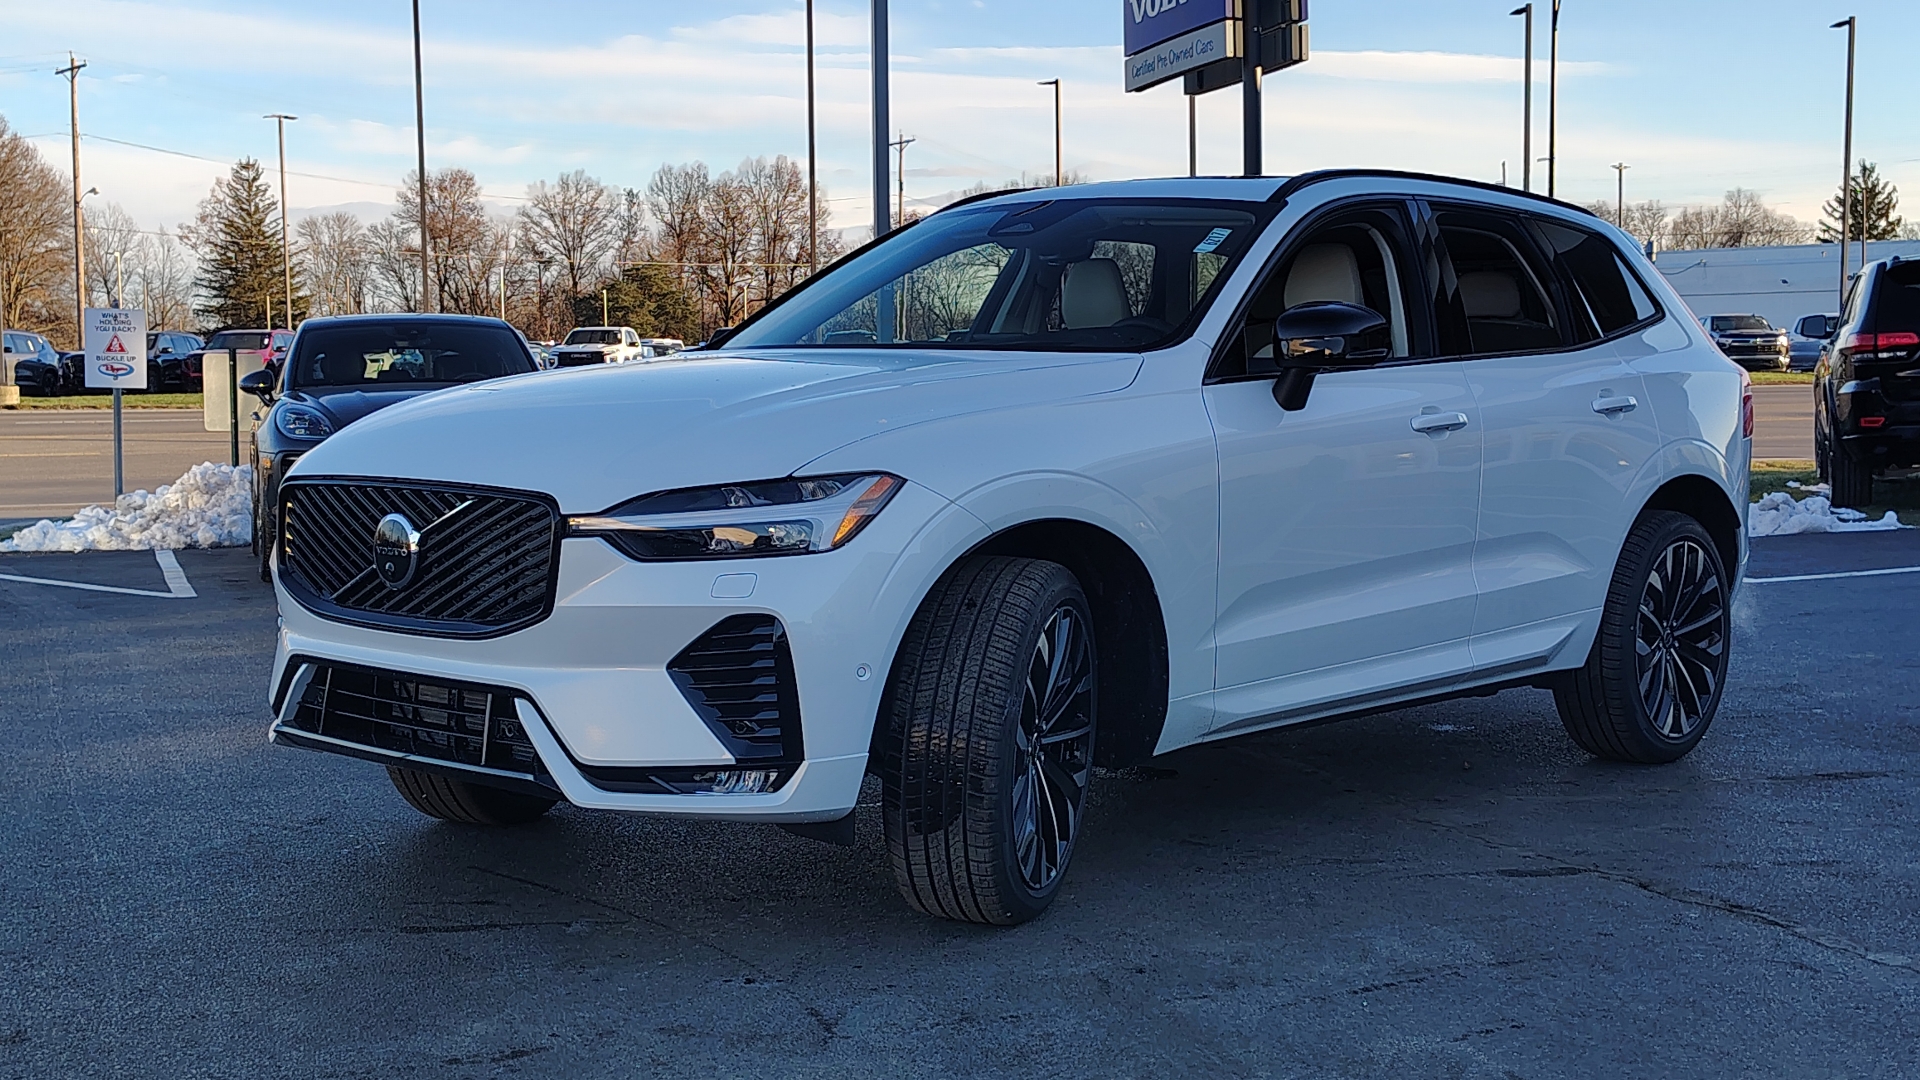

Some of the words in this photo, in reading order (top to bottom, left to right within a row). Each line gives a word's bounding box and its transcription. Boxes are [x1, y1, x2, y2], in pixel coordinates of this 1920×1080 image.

[1132, 56, 1156, 79] Certified
[1156, 53, 1168, 70] Pre
[1168, 42, 1194, 65] Owned
[1195, 39, 1214, 55] Cars
